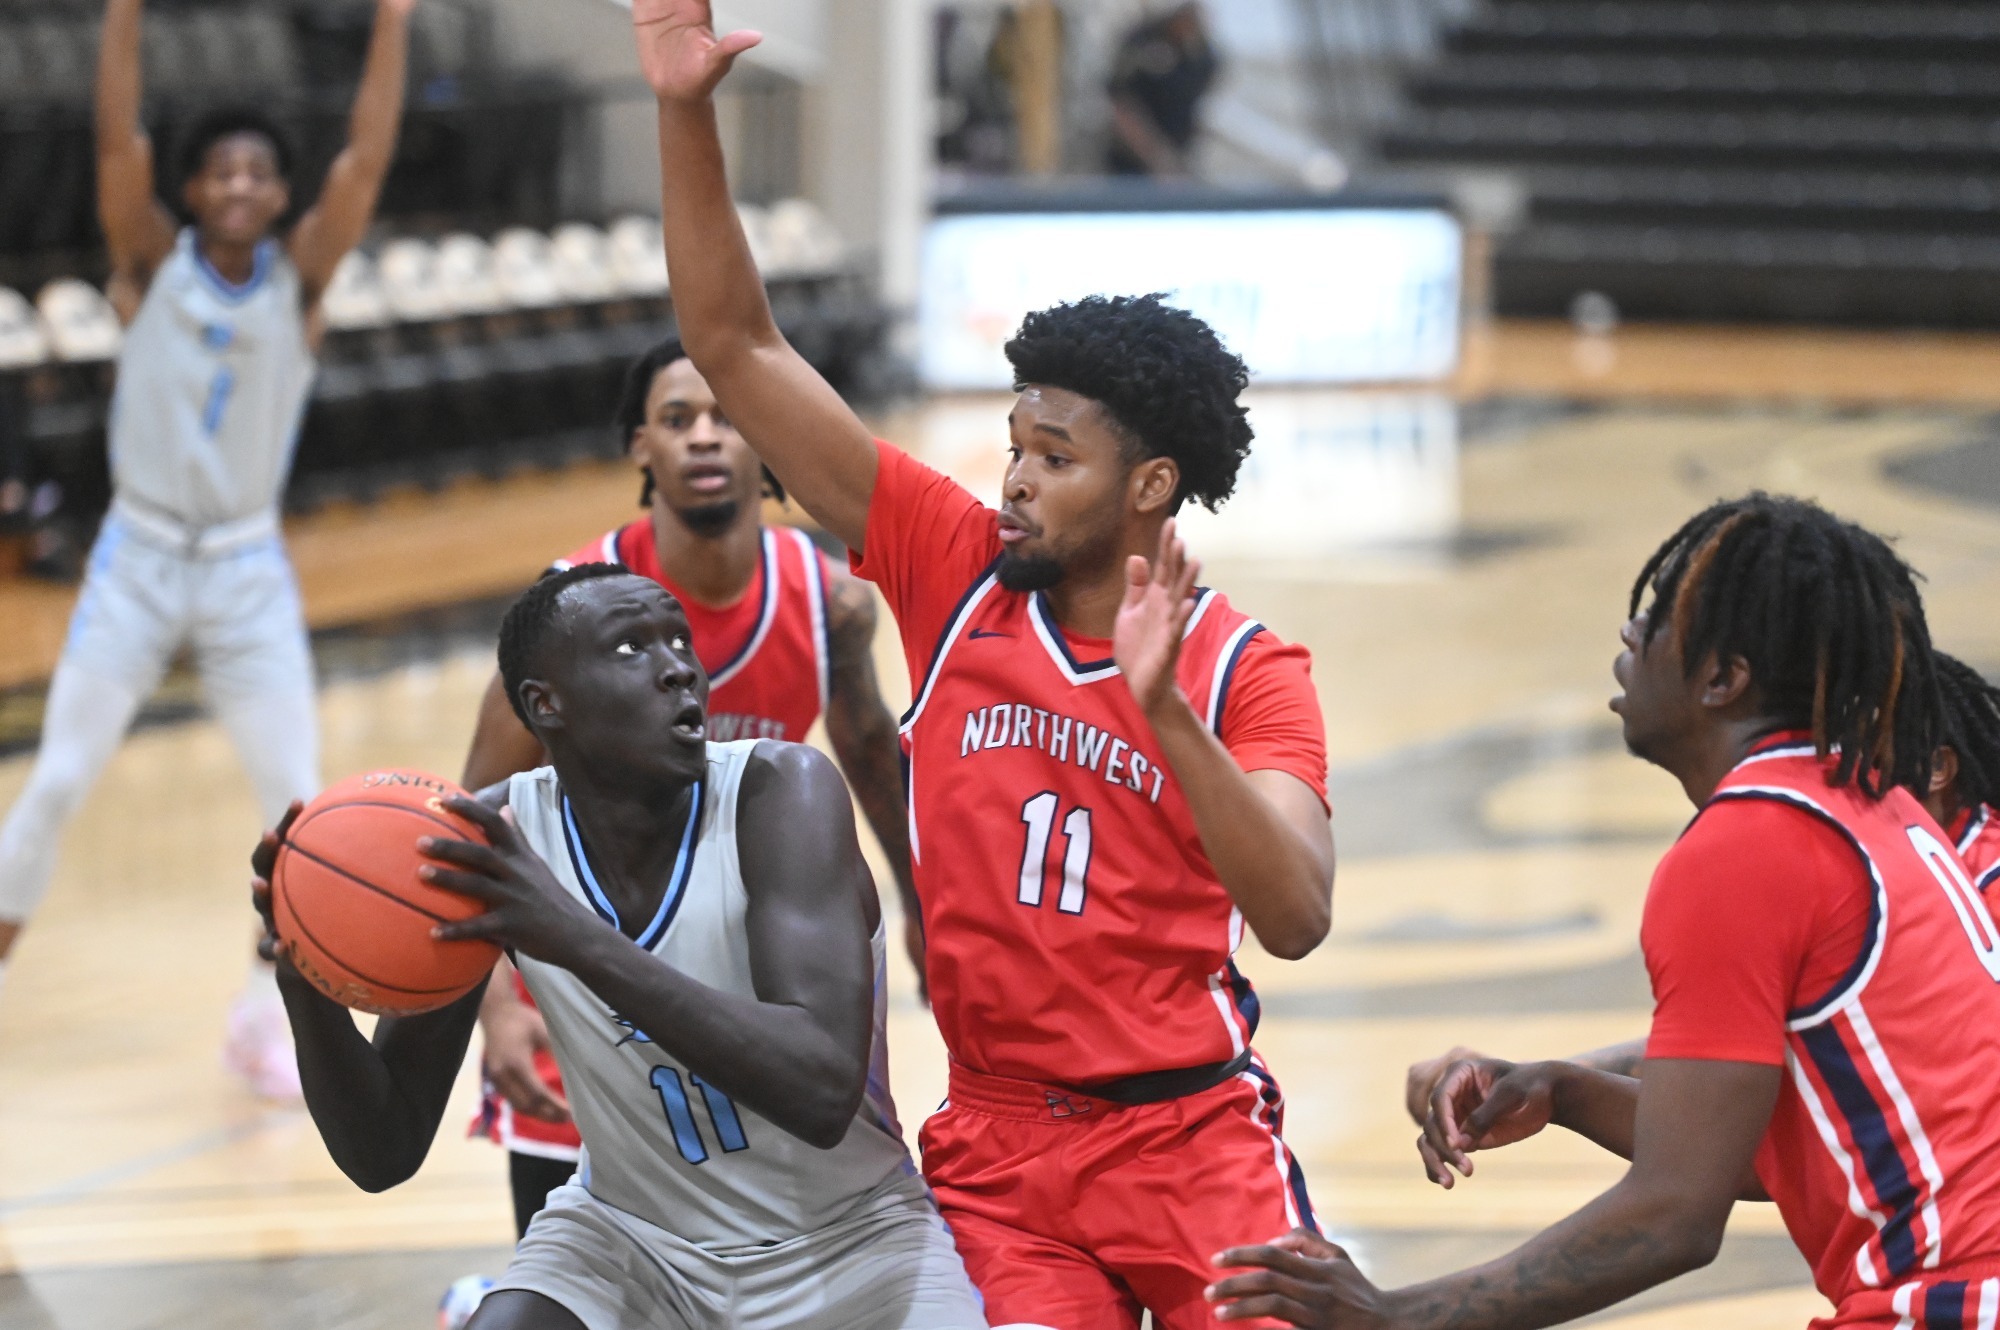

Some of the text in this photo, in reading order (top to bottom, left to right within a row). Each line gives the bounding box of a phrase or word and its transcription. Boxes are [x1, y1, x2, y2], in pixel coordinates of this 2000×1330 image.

[960, 702, 1166, 804] NORTHWEST
[1016, 789, 1093, 917] 11
[649, 1064, 749, 1165] 11
